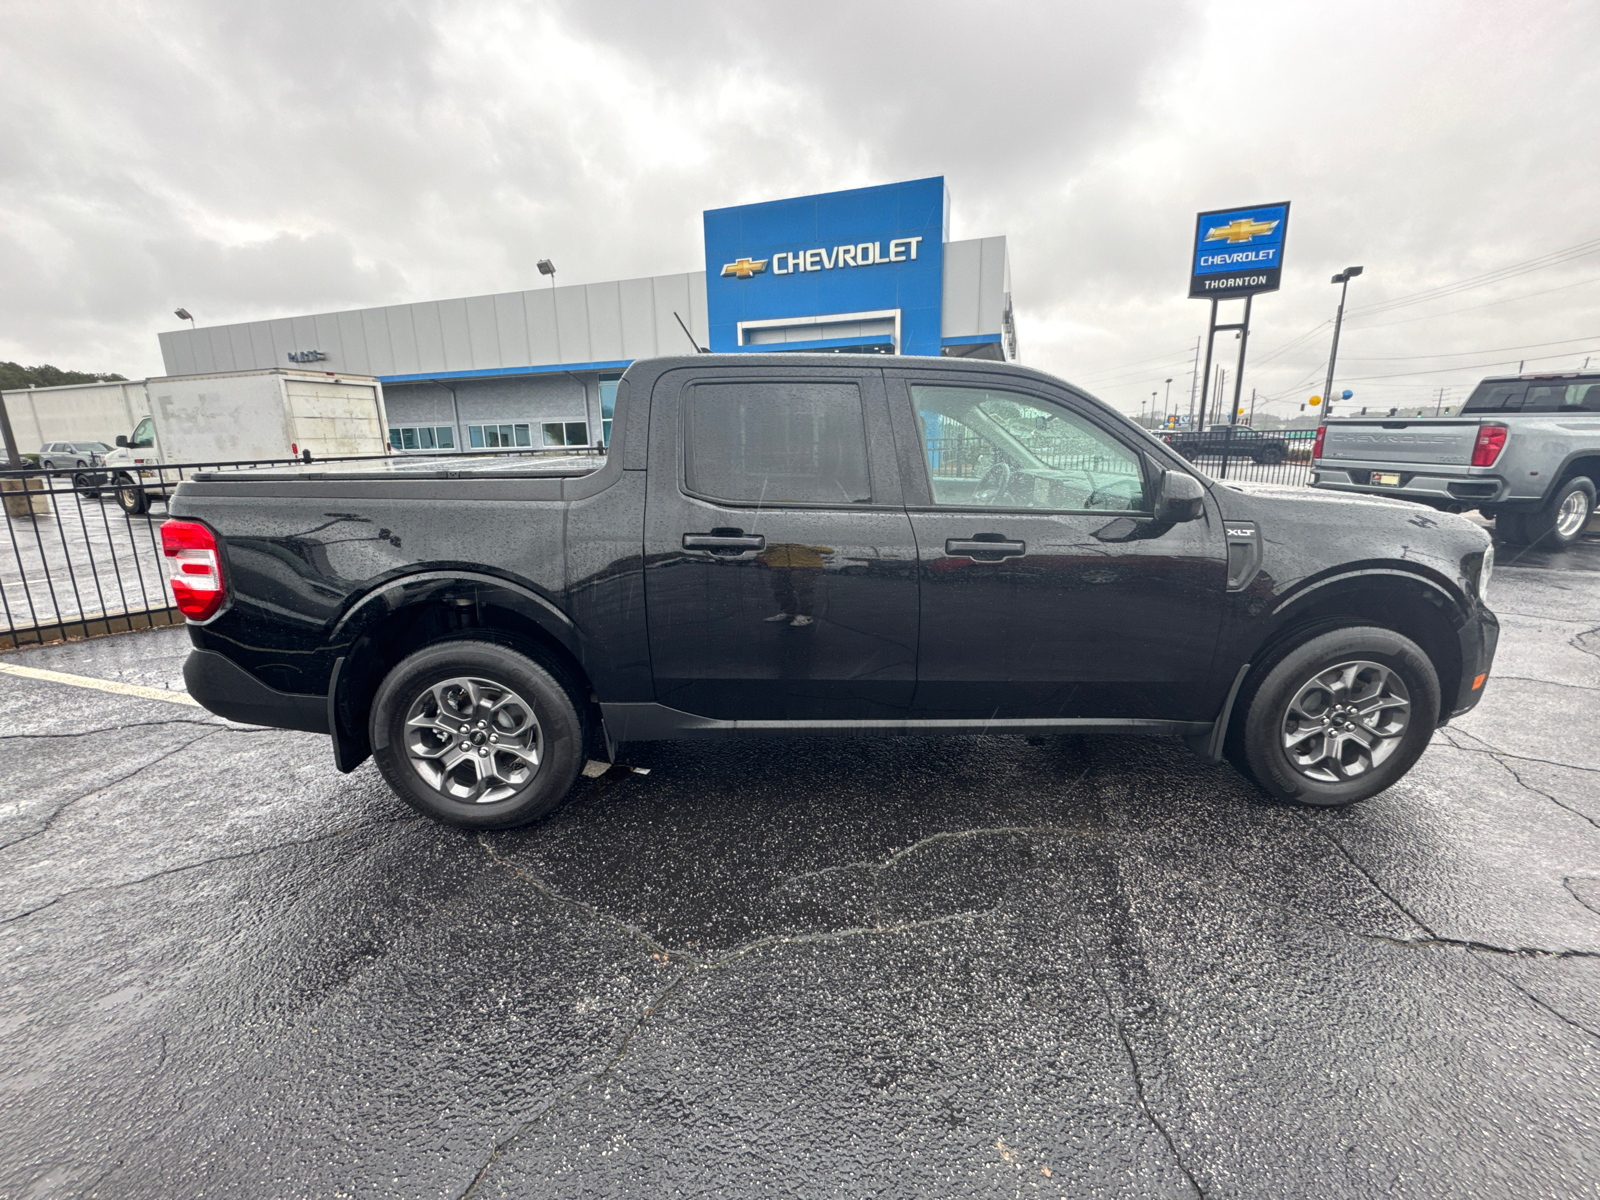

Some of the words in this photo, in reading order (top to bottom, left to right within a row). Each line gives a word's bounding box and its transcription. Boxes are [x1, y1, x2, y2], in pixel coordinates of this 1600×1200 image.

[773, 236, 923, 275] CHEVROLET
[1200, 249, 1275, 267] CHEVROLET
[1204, 275, 1267, 290] THORNTON
[1331, 433, 1462, 445] CHEVROLET
[1227, 528, 1255, 536] XLT
